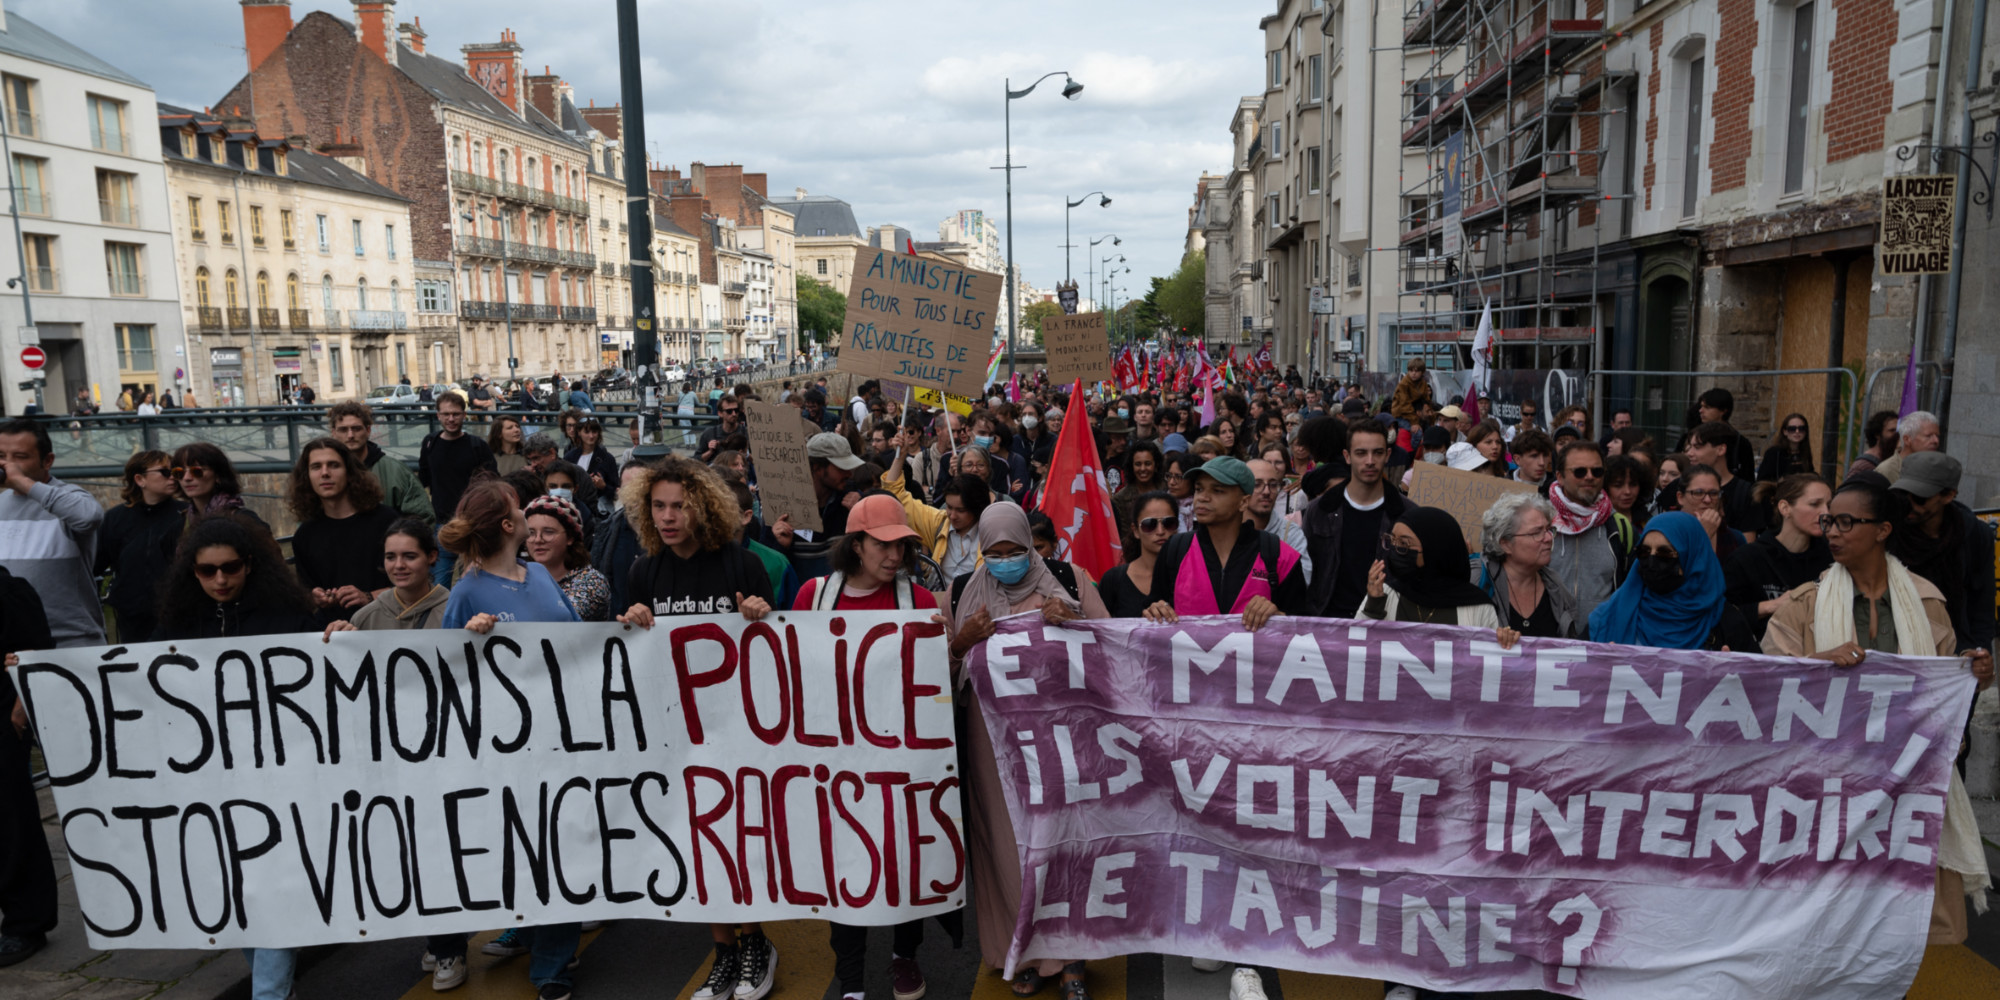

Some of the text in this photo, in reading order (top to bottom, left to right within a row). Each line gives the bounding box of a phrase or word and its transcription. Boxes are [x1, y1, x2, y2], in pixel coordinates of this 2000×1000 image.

[1886, 177, 1954, 198] LA POSTE
[867, 252, 977, 300] AMNISTIE
[1882, 252, 1949, 273] VILLAGE
[861, 287, 985, 330] POUR TOUS LES
[1046, 318, 1101, 331] LA FRANCE
[852, 322, 968, 362] RÉVOLTÉES DE
[1056, 344, 1102, 354] MONARCHIE
[894, 361, 962, 387] JUILLET
[1058, 362, 1102, 373] DICTATURE
[1412, 487, 1477, 513] ABAYAS
[985, 626, 1097, 698] ET
[18, 635, 532, 787] DÉSARMONS
[540, 637, 647, 752] LA
[1170, 753, 1440, 845] VONT
[62, 800, 282, 938] STOP
[1032, 851, 1136, 926] LE
[1548, 892, 1604, 986] ?
